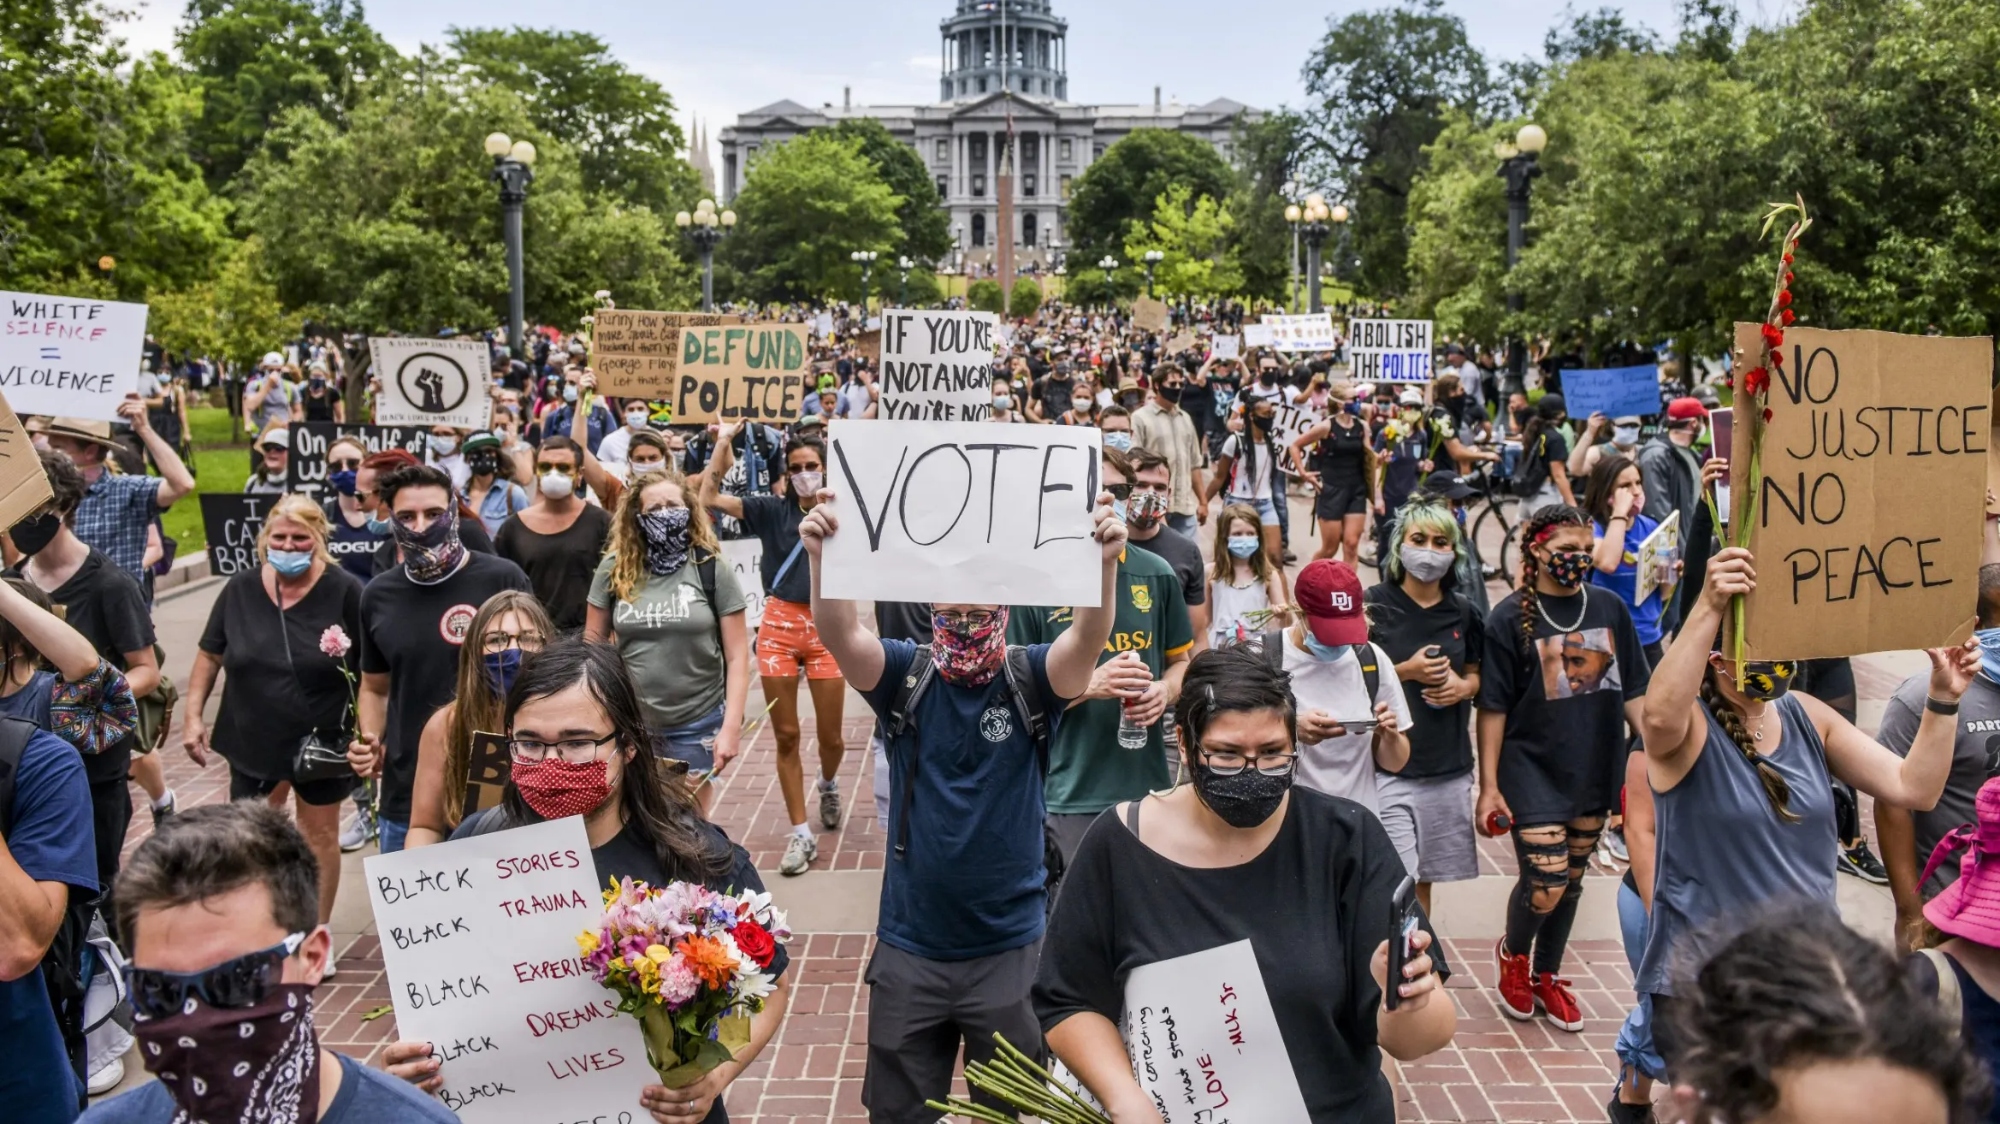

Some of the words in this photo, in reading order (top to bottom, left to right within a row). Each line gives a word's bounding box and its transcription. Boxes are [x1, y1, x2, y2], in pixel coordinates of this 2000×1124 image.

[13, 300, 104, 320] WHITE
[6, 321, 107, 341] SILENCE
[684, 329, 803, 371] DEFUND
[886, 315, 913, 354] IF
[924, 316, 992, 354] YOU'RE
[1352, 323, 1426, 348] ABOLISH
[0, 366, 114, 393] VIOLENCE
[883, 361, 932, 394] NOT
[932, 363, 992, 392] ANGRY
[1352, 353, 1379, 378] THE
[1383, 353, 1429, 379] POLICE
[1764, 345, 1839, 404] NO
[678, 375, 800, 418] POLICE
[297, 427, 326, 456] On
[406, 431, 425, 453] of
[1786, 405, 1988, 461] JUSTICE
[243, 498, 262, 521] I
[832, 438, 1098, 552] VOTE!
[1762, 471, 1845, 527] NO
[328, 541, 385, 554] ROGU
[1784, 537, 1952, 604] PEACE
[1967, 719, 2000, 733] PART
[377, 867, 474, 904] BLACK
[496, 850, 580, 879] STORIES
[390, 917, 470, 949] BLACK
[499, 889, 587, 918] TRAUMA
[406, 975, 490, 1009] BLACK
[513, 957, 591, 983] EXPERIE
[1220, 982, 1237, 1005] Jr
[426, 1036, 499, 1067] BLACK
[526, 1000, 617, 1037] DREAMS
[1159, 1006, 1184, 1059] stands
[438, 1082, 515, 1112] BLACK
[547, 1048, 625, 1079] LIVES
[1175, 1067, 1197, 1105] that
